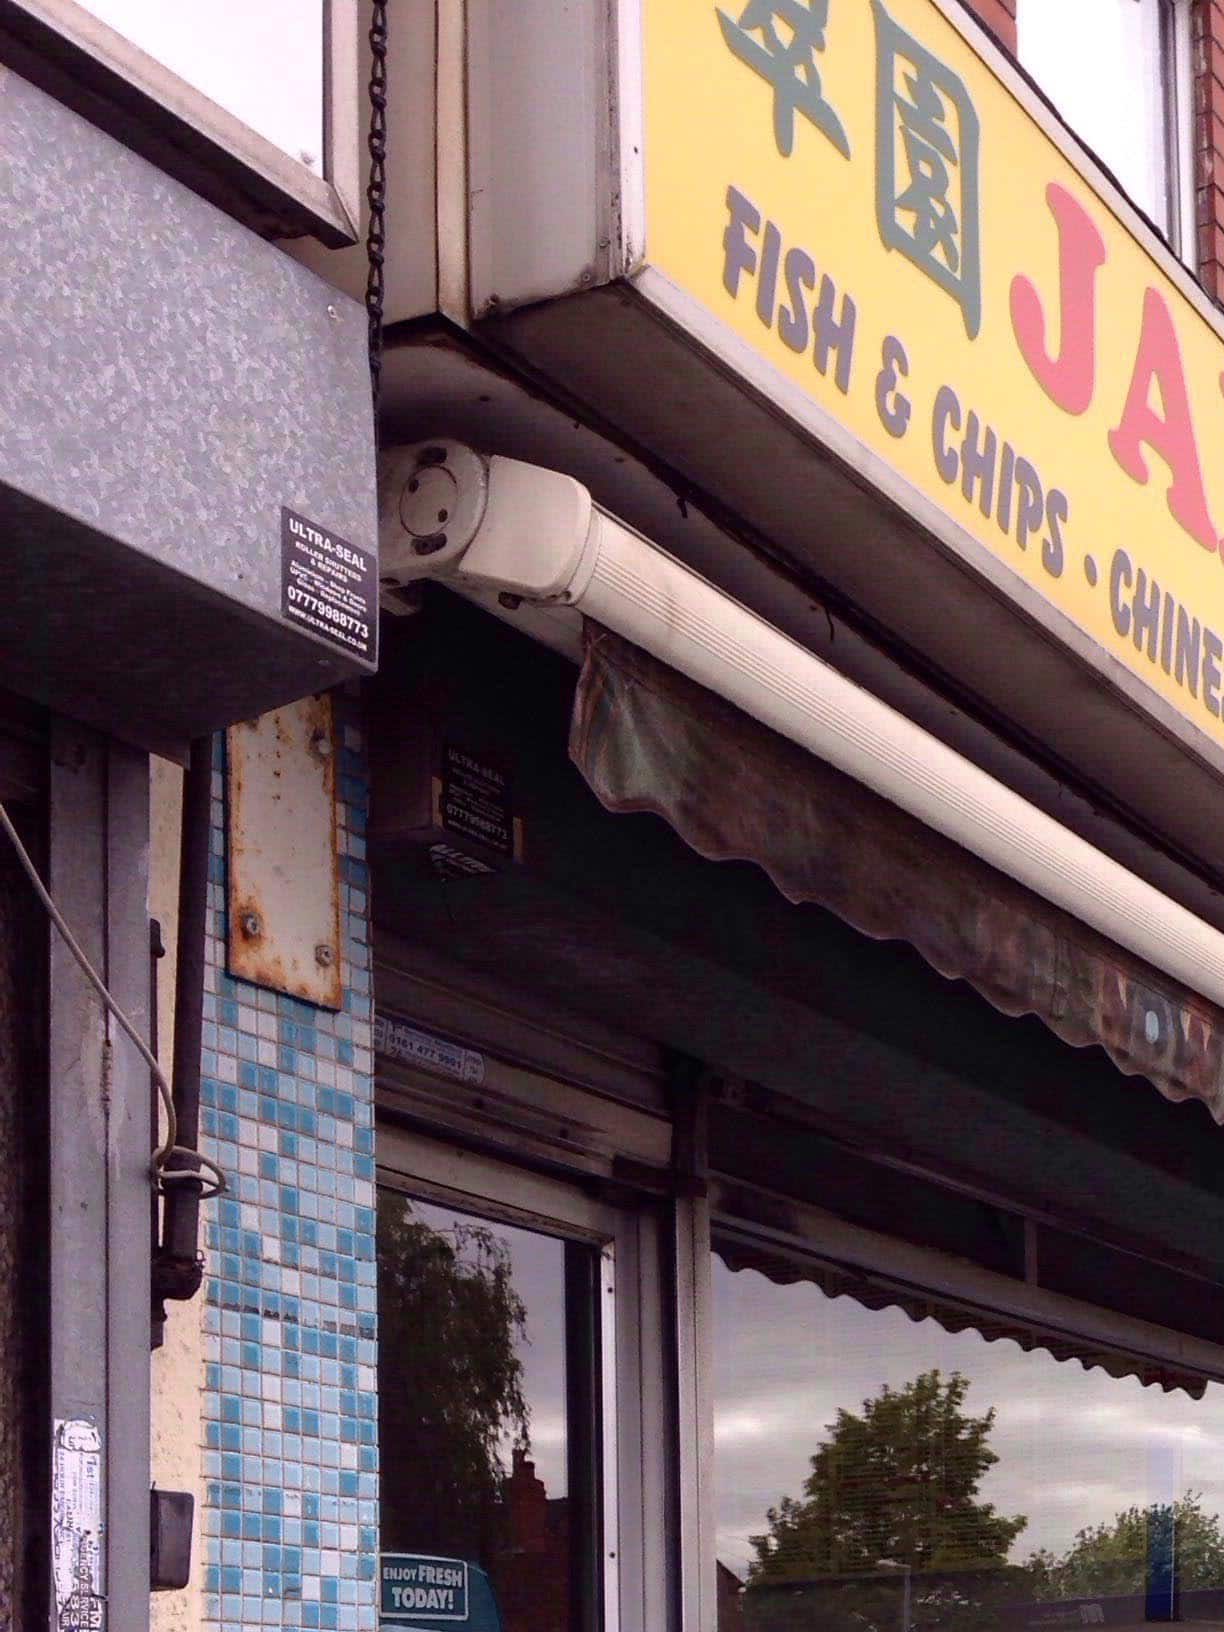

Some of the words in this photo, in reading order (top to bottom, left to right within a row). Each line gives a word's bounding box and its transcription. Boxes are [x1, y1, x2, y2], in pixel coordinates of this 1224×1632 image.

[723, 184, 857, 396] FISH
[875, 335, 911, 438] &
[932, 385, 1068, 578] CHIPS
[289, 518, 367, 572] ULTRA-SEAL
[295, 541, 324, 562] ROLLER
[325, 557, 362, 582] SHUTTERS
[317, 561, 348, 583] REPAIRS
[287, 585, 369, 639] 07779988773
[383, 1566, 417, 1580] ENJOY
[418, 1564, 462, 1588] FRESH
[391, 1586, 454, 1610] TODAY!
